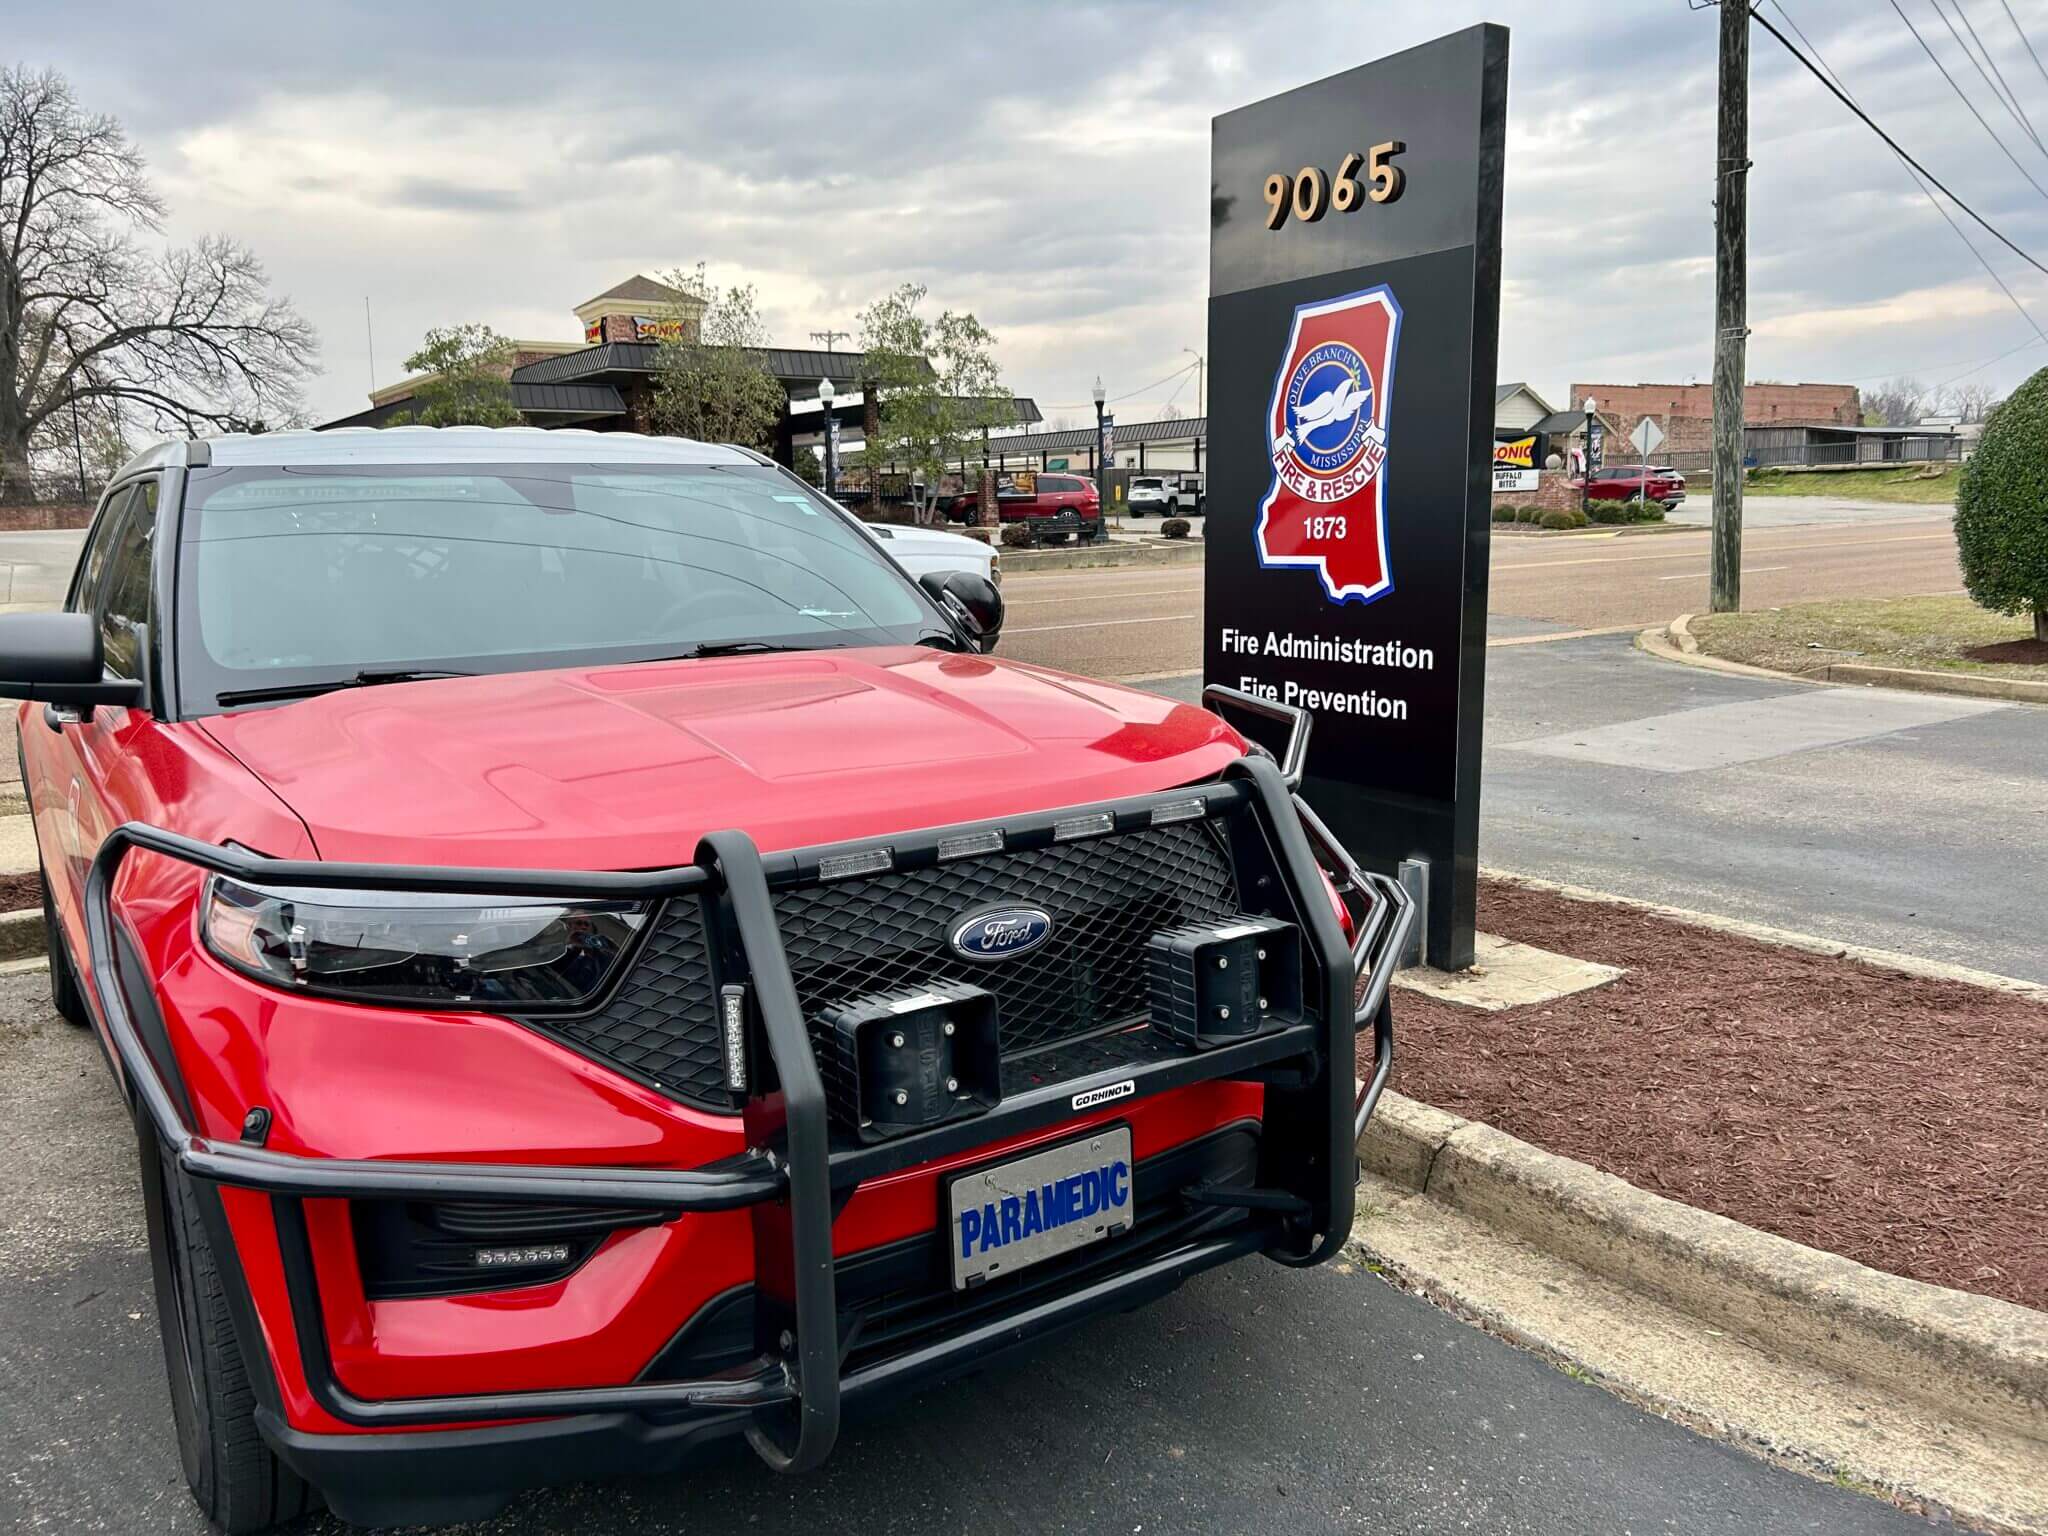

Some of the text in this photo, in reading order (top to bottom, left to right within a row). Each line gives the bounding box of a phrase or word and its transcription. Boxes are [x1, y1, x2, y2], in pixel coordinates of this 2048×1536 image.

[1263, 141, 1406, 230] 9065
[1289, 348, 1352, 405] OLIVE BRANCH
[1310, 419, 1368, 468] MISSISSIPPI
[1494, 445, 1532, 459] ONIC
[1275, 442, 1384, 501] FIRE & RESCUE
[1495, 472, 1522, 480] BUFFALO
[1303, 515, 1347, 539] 1873
[1222, 628, 1434, 670] Fire Administration
[1240, 676, 1407, 720] Fire Prevention
[981, 918, 1032, 950] Ford
[960, 1160, 1128, 1259] PARAMEDIC
